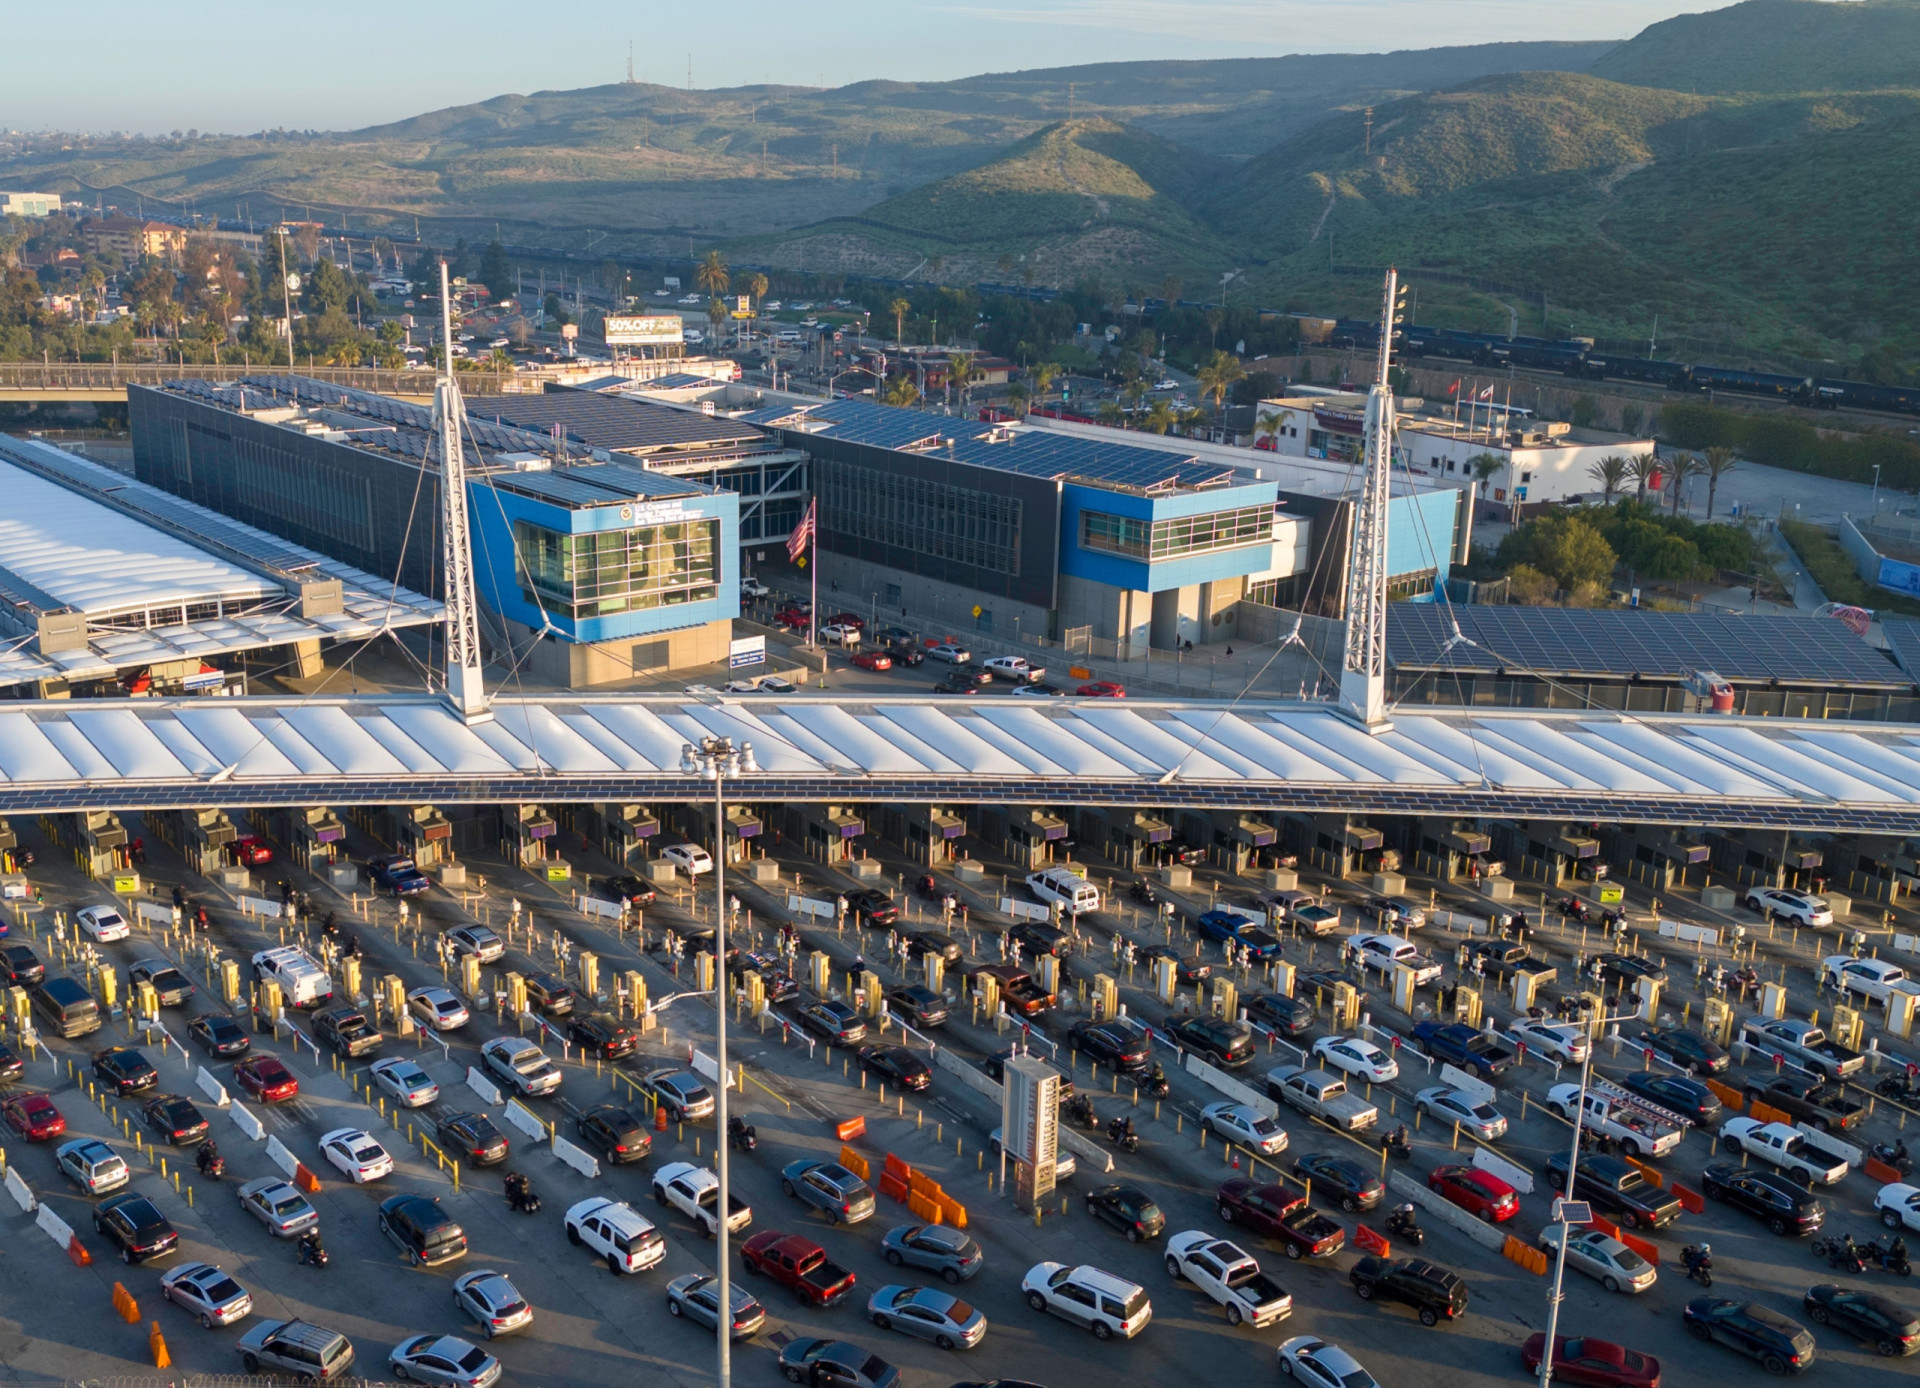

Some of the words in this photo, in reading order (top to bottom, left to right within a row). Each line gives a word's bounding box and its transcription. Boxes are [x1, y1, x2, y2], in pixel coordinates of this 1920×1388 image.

[1028, 1080, 1037, 1119] STATES
[1045, 1077, 1058, 1120] STATES
[1043, 1119, 1055, 1161] UNITED
